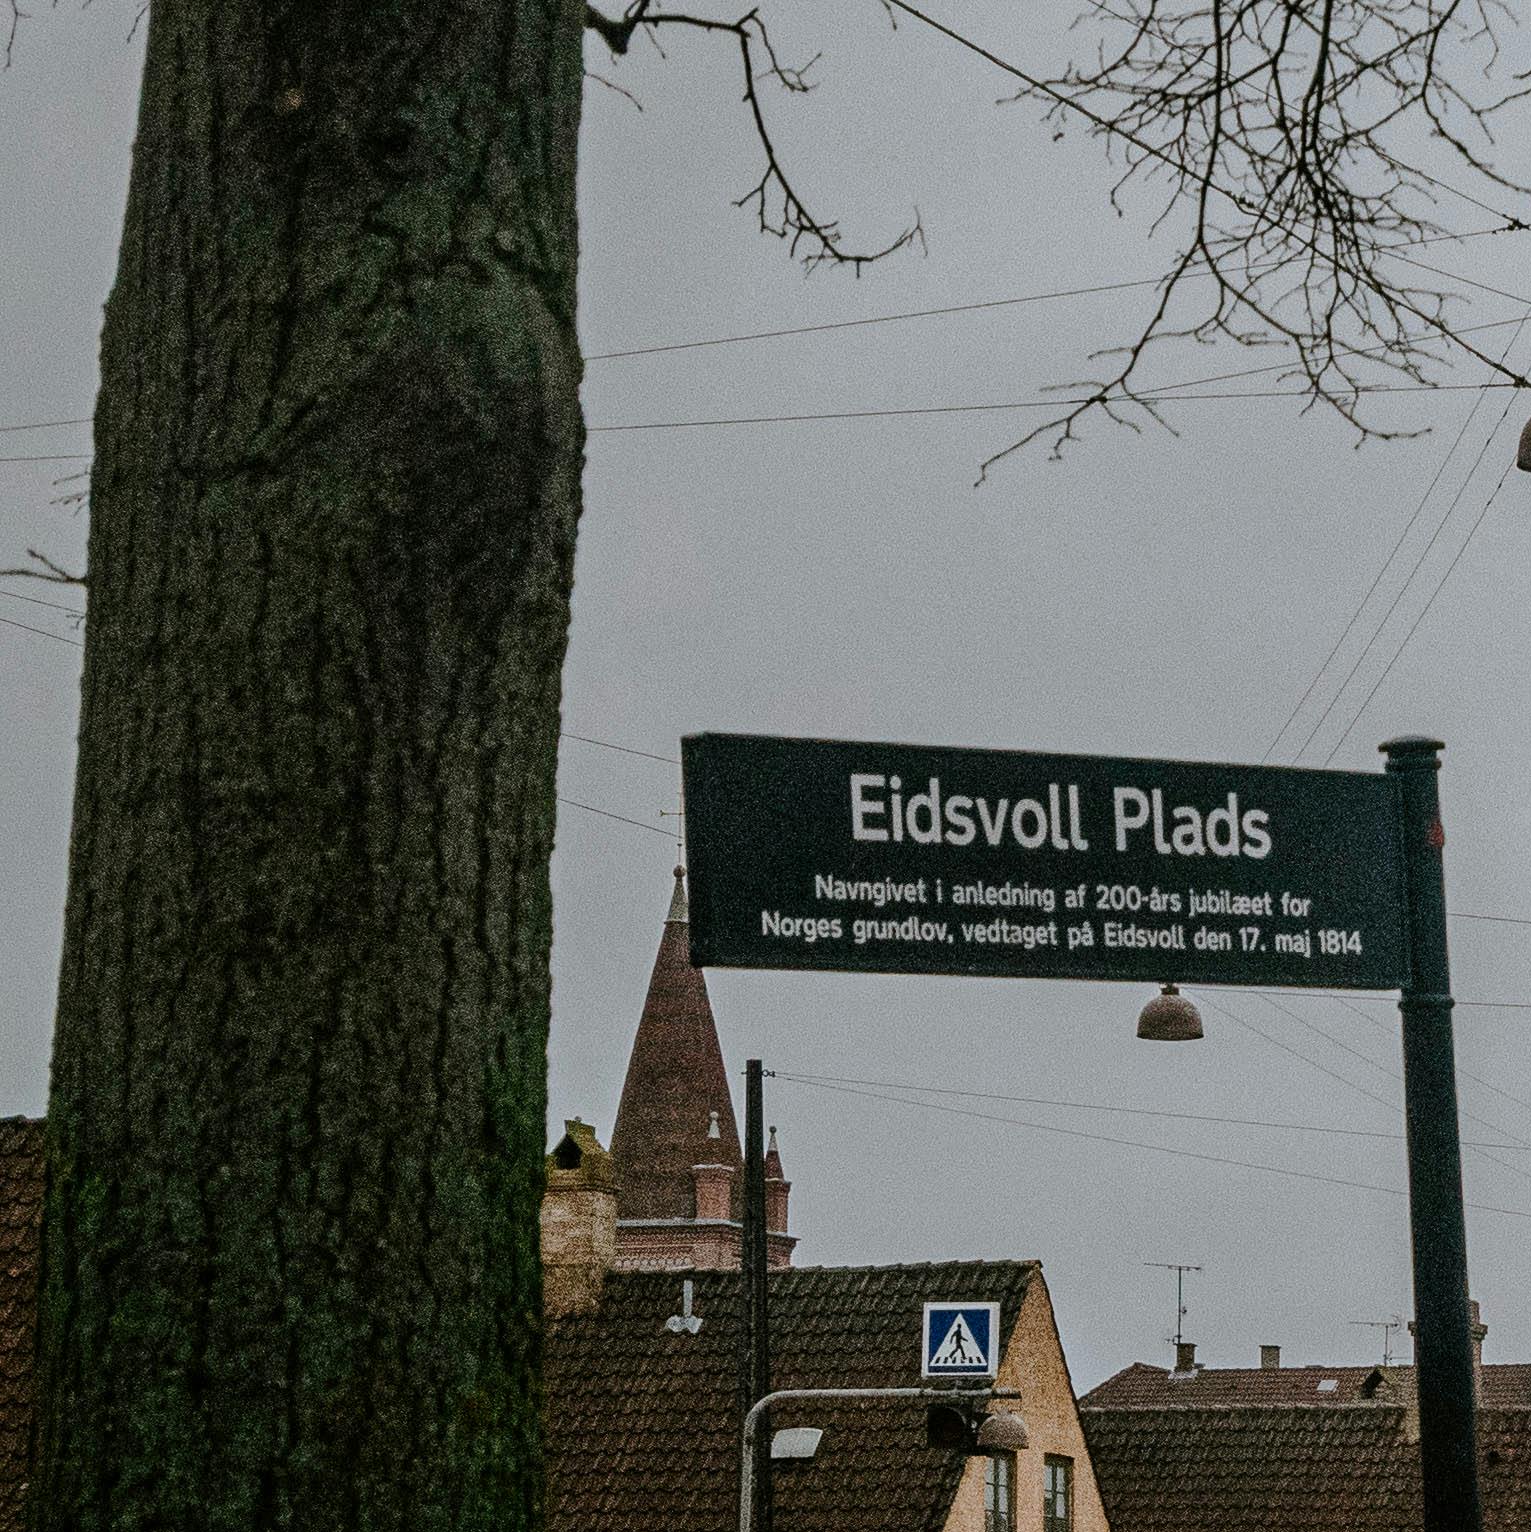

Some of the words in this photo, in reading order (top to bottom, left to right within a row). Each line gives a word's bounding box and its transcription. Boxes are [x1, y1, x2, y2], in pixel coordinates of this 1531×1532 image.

[850, 773, 1089, 851] Eidsvoll
[1113, 787, 1272, 859] Plads
[815, 874, 927, 907] Navngivet
[936, 879, 943, 903] i
[952, 880, 1056, 913] anledning
[1064, 884, 1087, 908] af
[1096, 884, 1182, 912] 200-års
[1188, 888, 1273, 917] jubilæet
[1280, 891, 1312, 917] for
[761, 910, 843, 943] Norges
[852, 916, 954, 944] grundlov,
[961, 918, 1060, 949] vedtaget
[1067, 921, 1094, 950] på
[1104, 922, 1187, 949] Eidsvoll
[1193, 926, 1232, 950] den
[1238, 926, 1267, 951] 17.
[1274, 929, 1312, 958] maj
[1317, 929, 1363, 955] 1814
